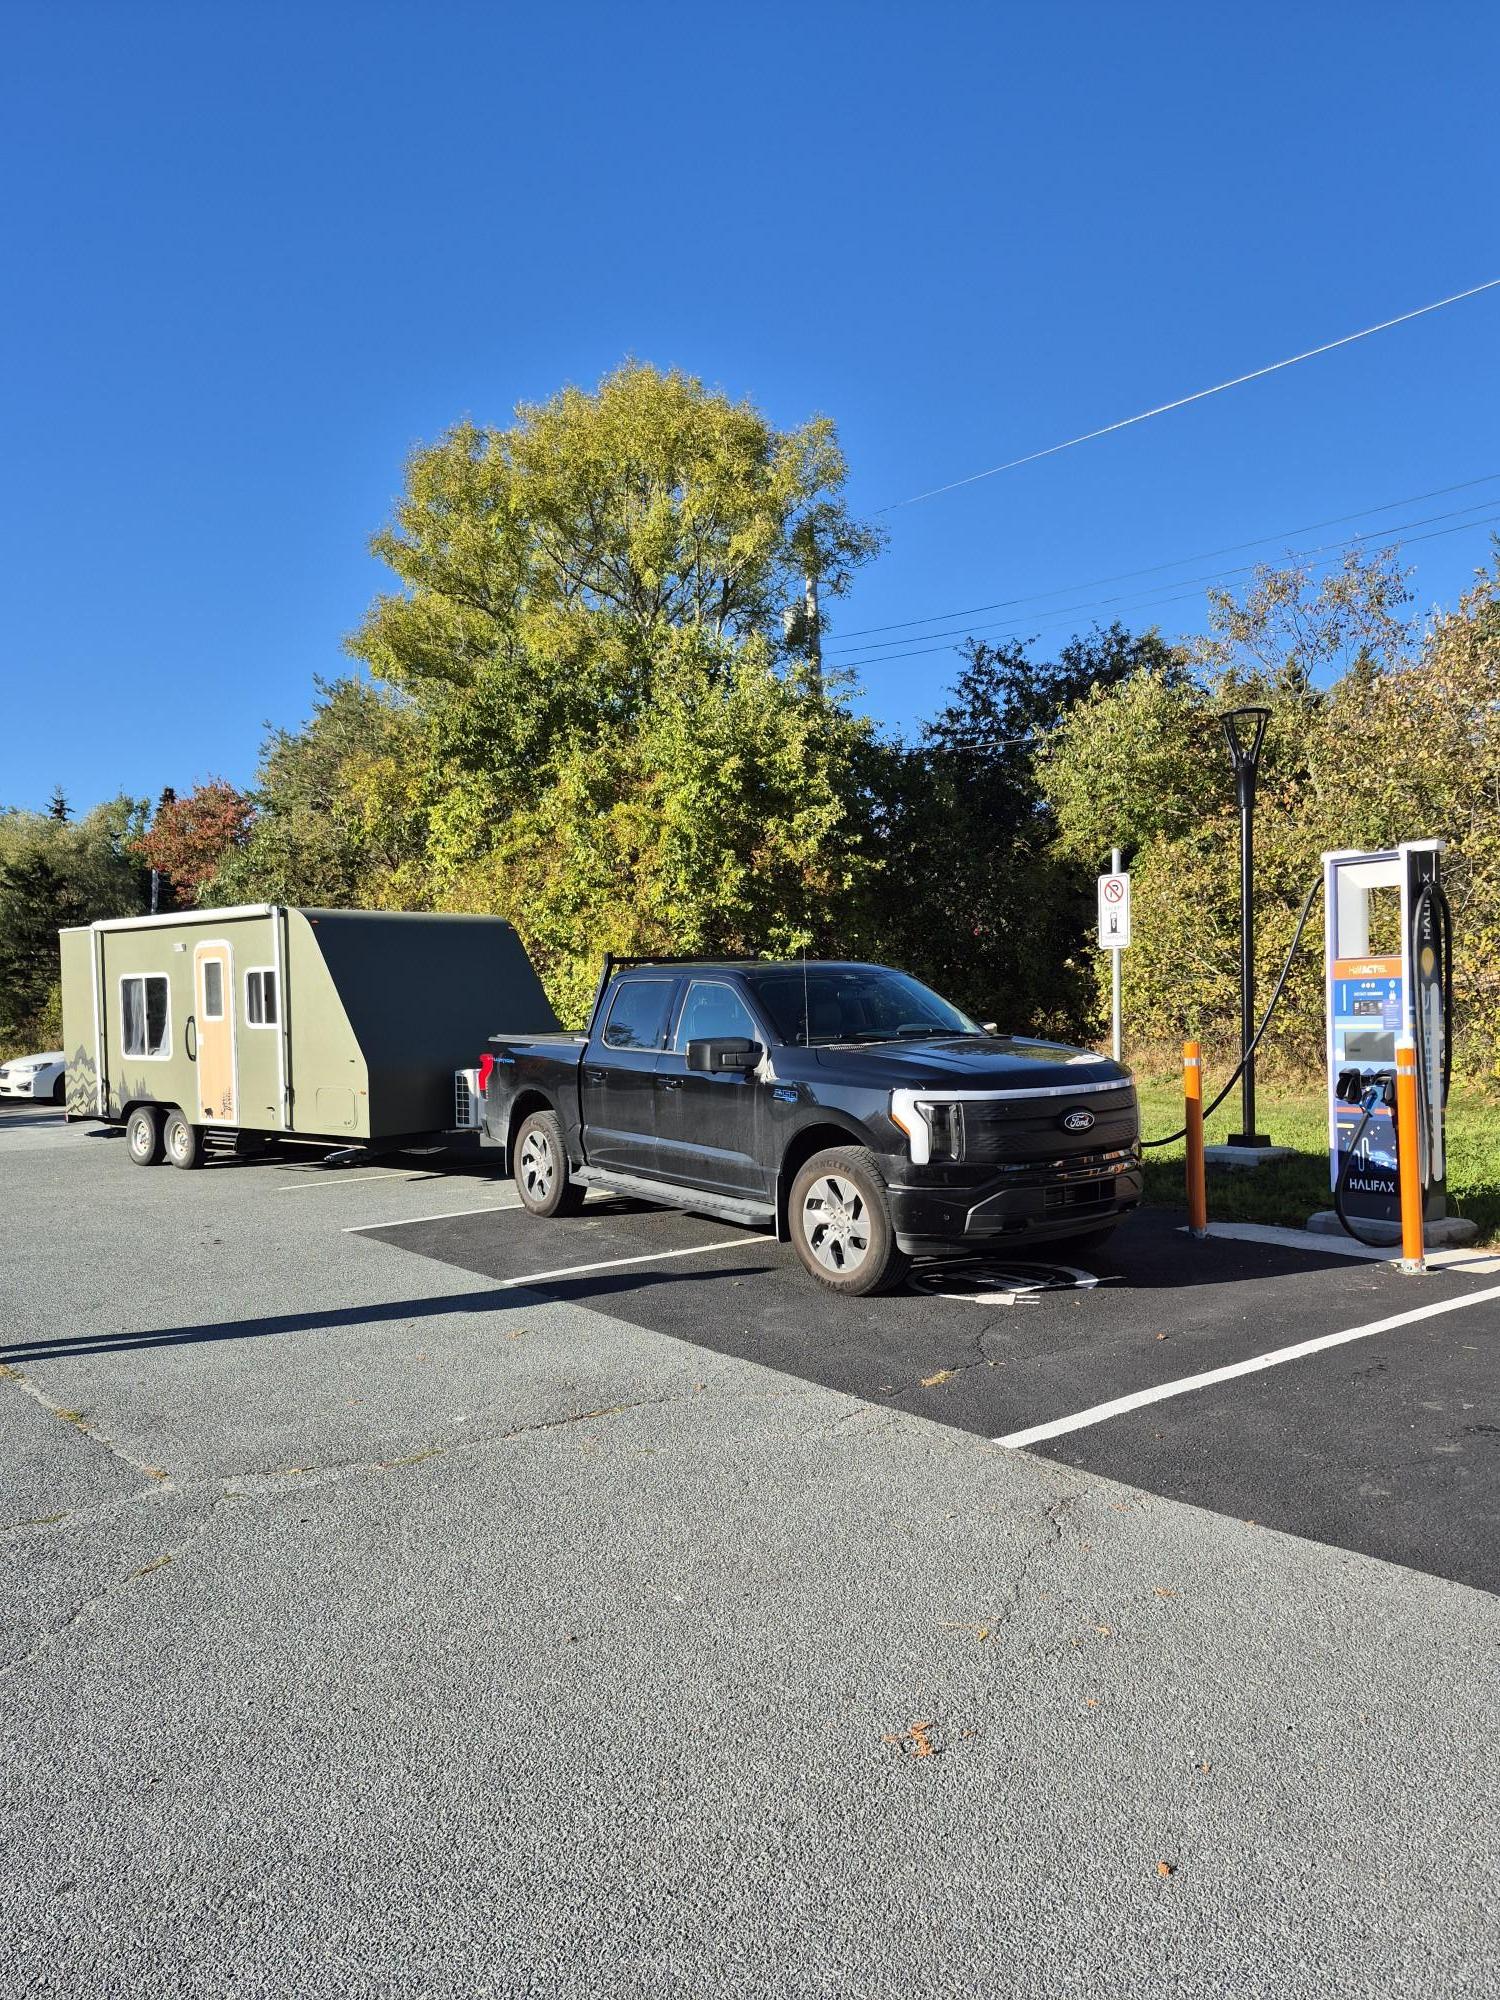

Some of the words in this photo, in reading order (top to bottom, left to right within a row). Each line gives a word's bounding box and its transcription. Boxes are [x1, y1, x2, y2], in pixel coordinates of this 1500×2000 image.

[1422, 872, 1431, 940] HALIX
[1070, 1115, 1090, 1128] Ford
[1349, 1177, 1395, 1193] HALIFAX
